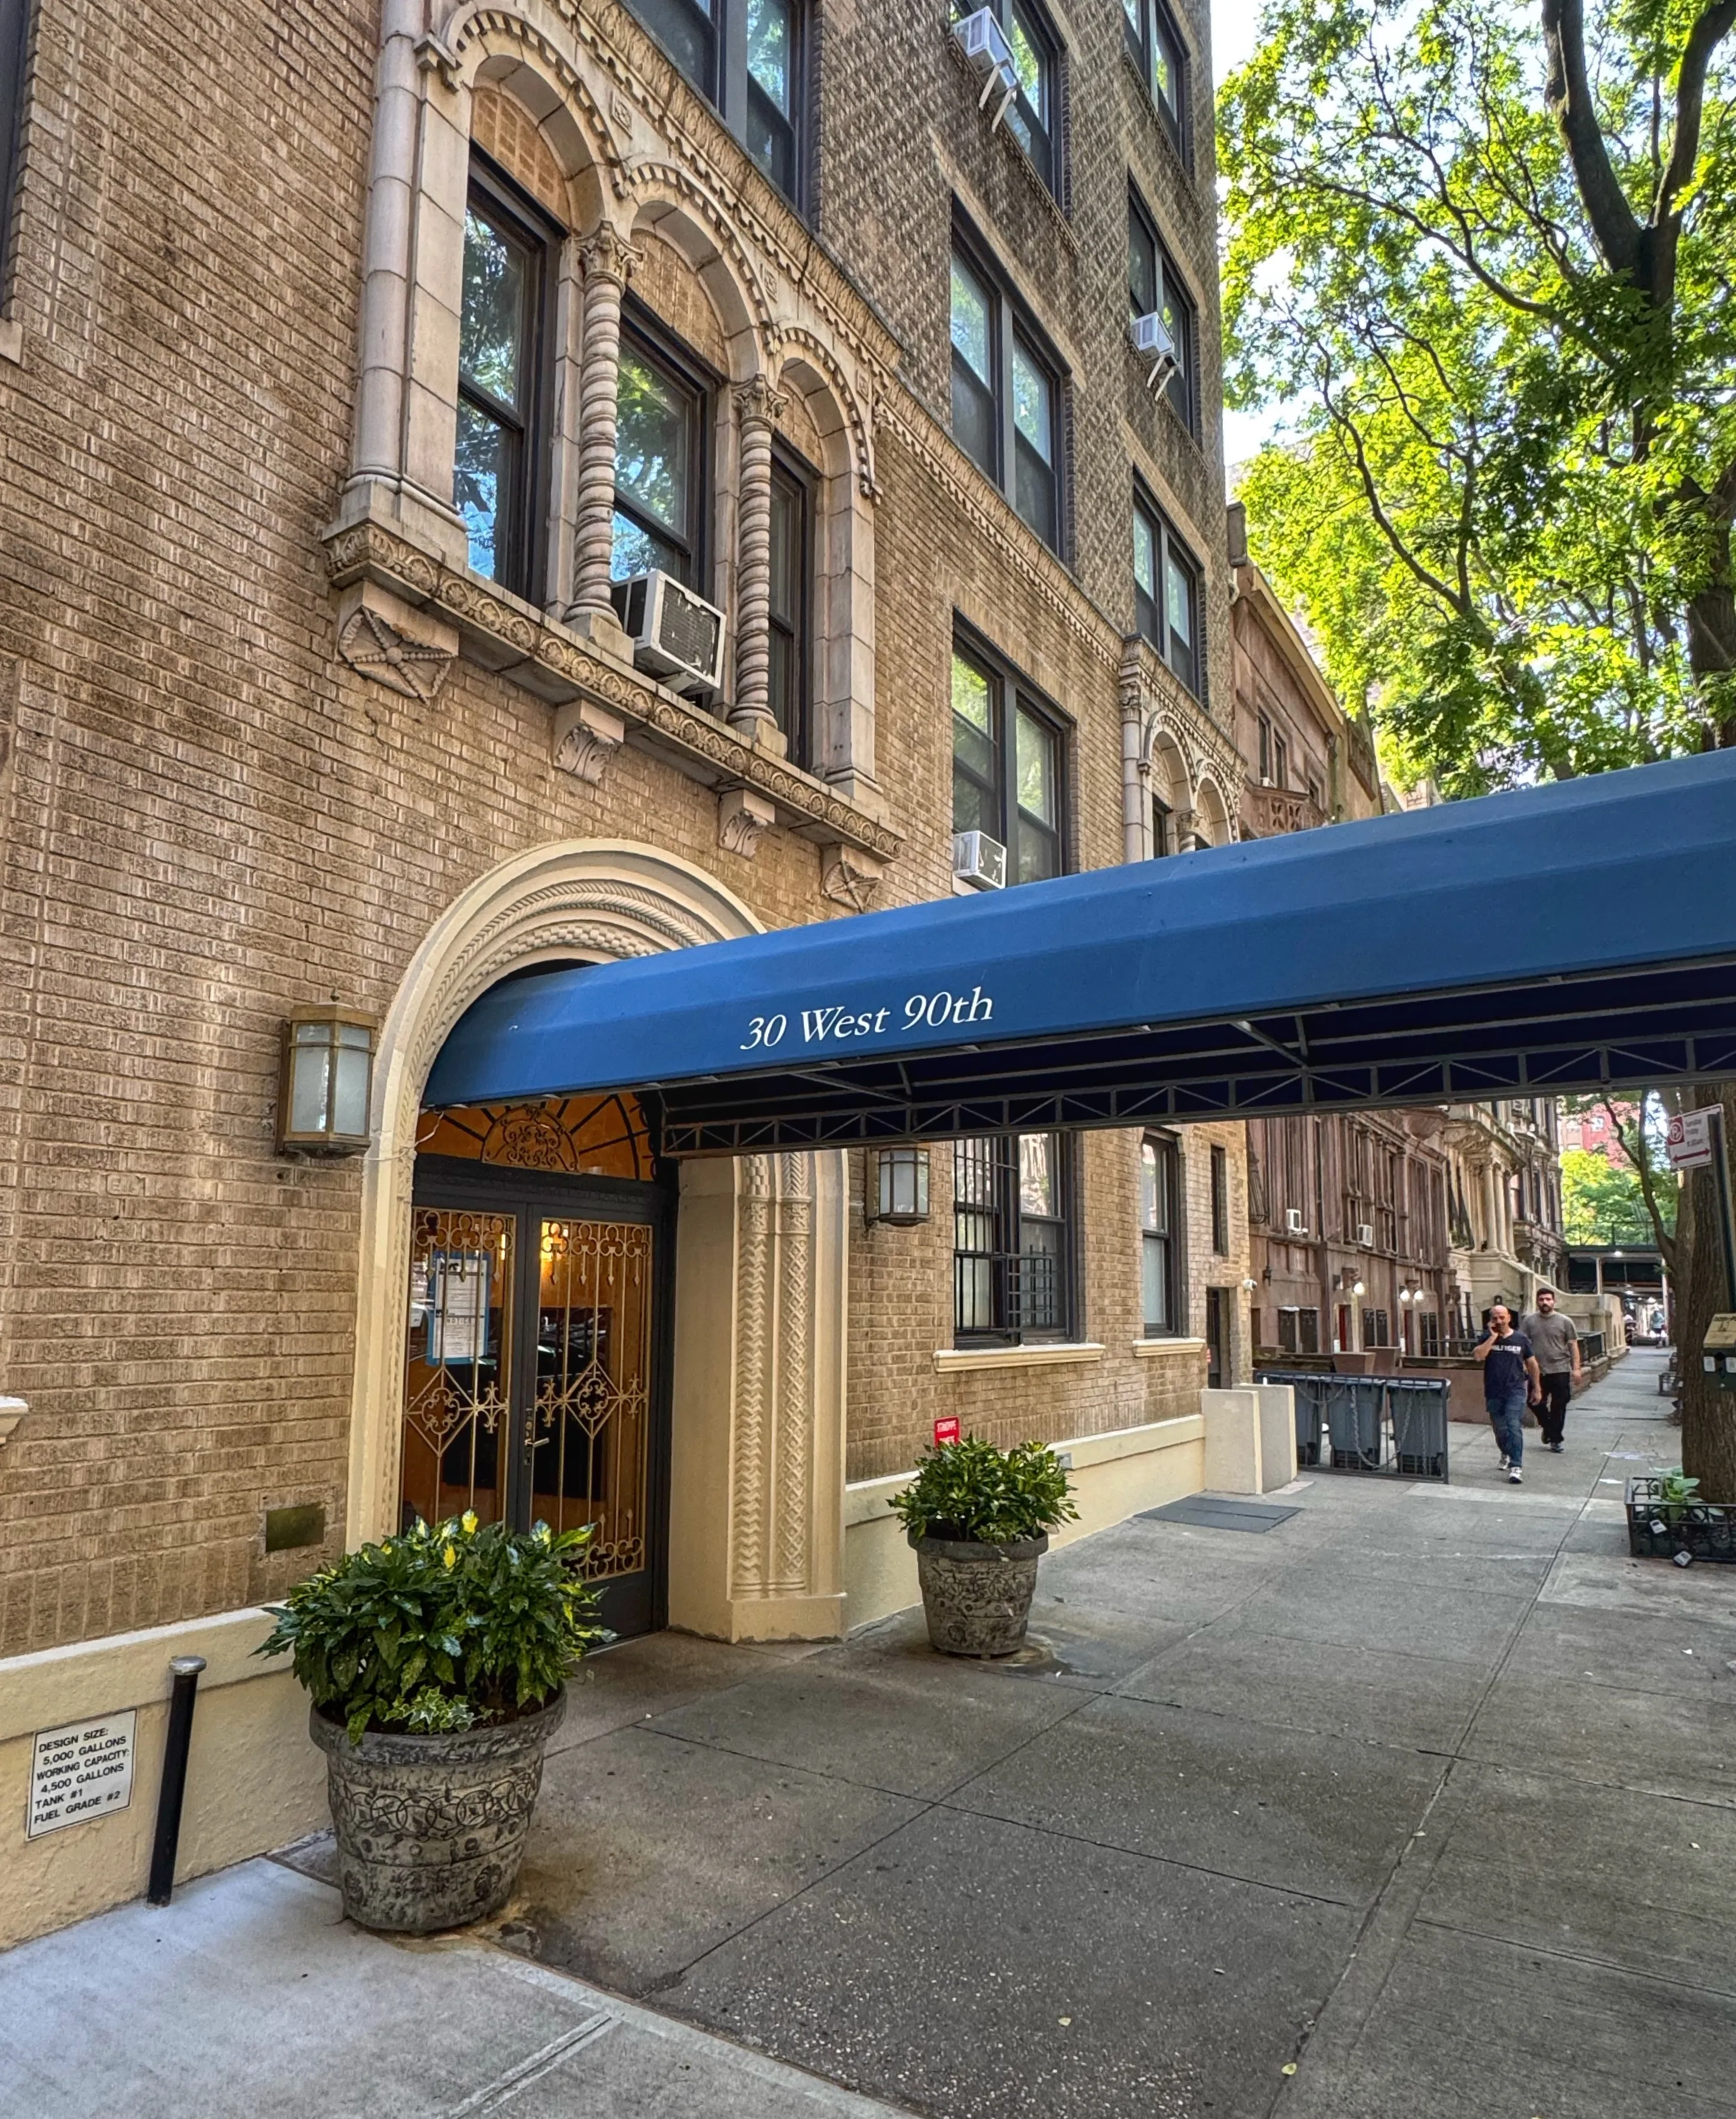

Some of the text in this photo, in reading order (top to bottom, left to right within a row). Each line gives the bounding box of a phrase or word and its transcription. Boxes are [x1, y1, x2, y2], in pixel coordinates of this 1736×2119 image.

[739, 986, 994, 1051] 30 West 90th
[38, 1728, 109, 1753] DESIGN SIZE:
[43, 1735, 126, 1765] 5,000 GALLONS
[37, 1748, 130, 1781] WORKING CAPACITY:
[41, 1763, 124, 1793] 4,500 GALLONS
[34, 1790, 121, 1824] FUEL GRADE #2
[35, 1789, 83, 1809] TANK #1
